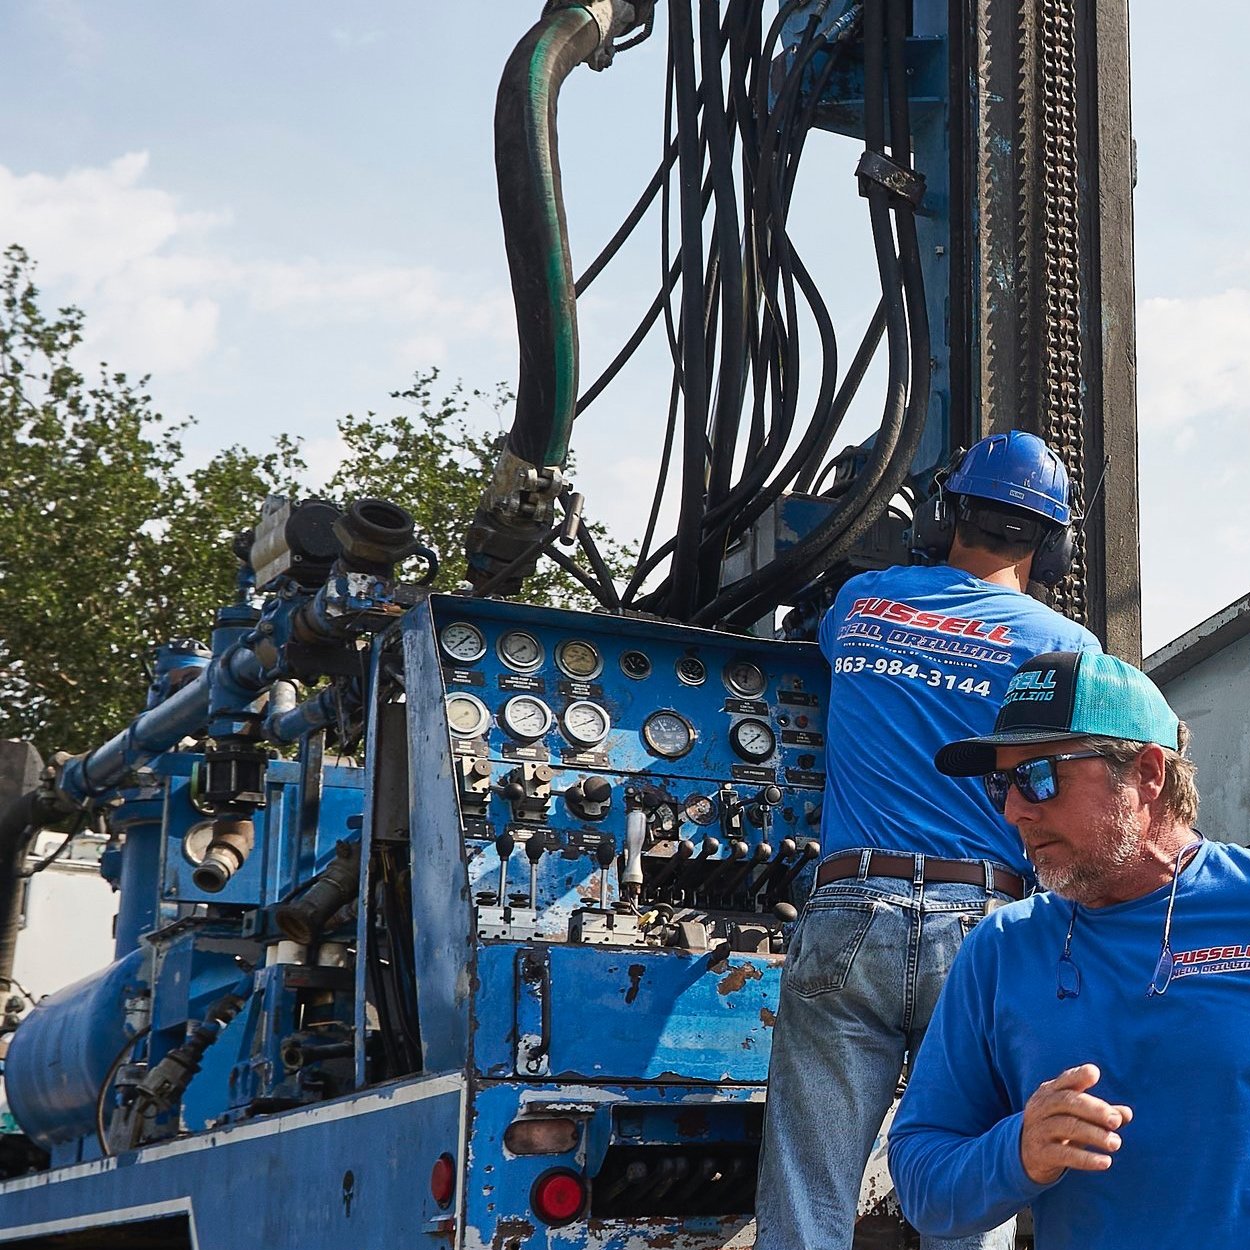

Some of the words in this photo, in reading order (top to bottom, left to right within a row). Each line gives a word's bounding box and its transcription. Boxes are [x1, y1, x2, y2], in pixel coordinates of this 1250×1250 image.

[844, 597, 1014, 645] FUSSELL
[886, 629, 1012, 664] DRILLING
[835, 656, 991, 697] 863-984-3144
